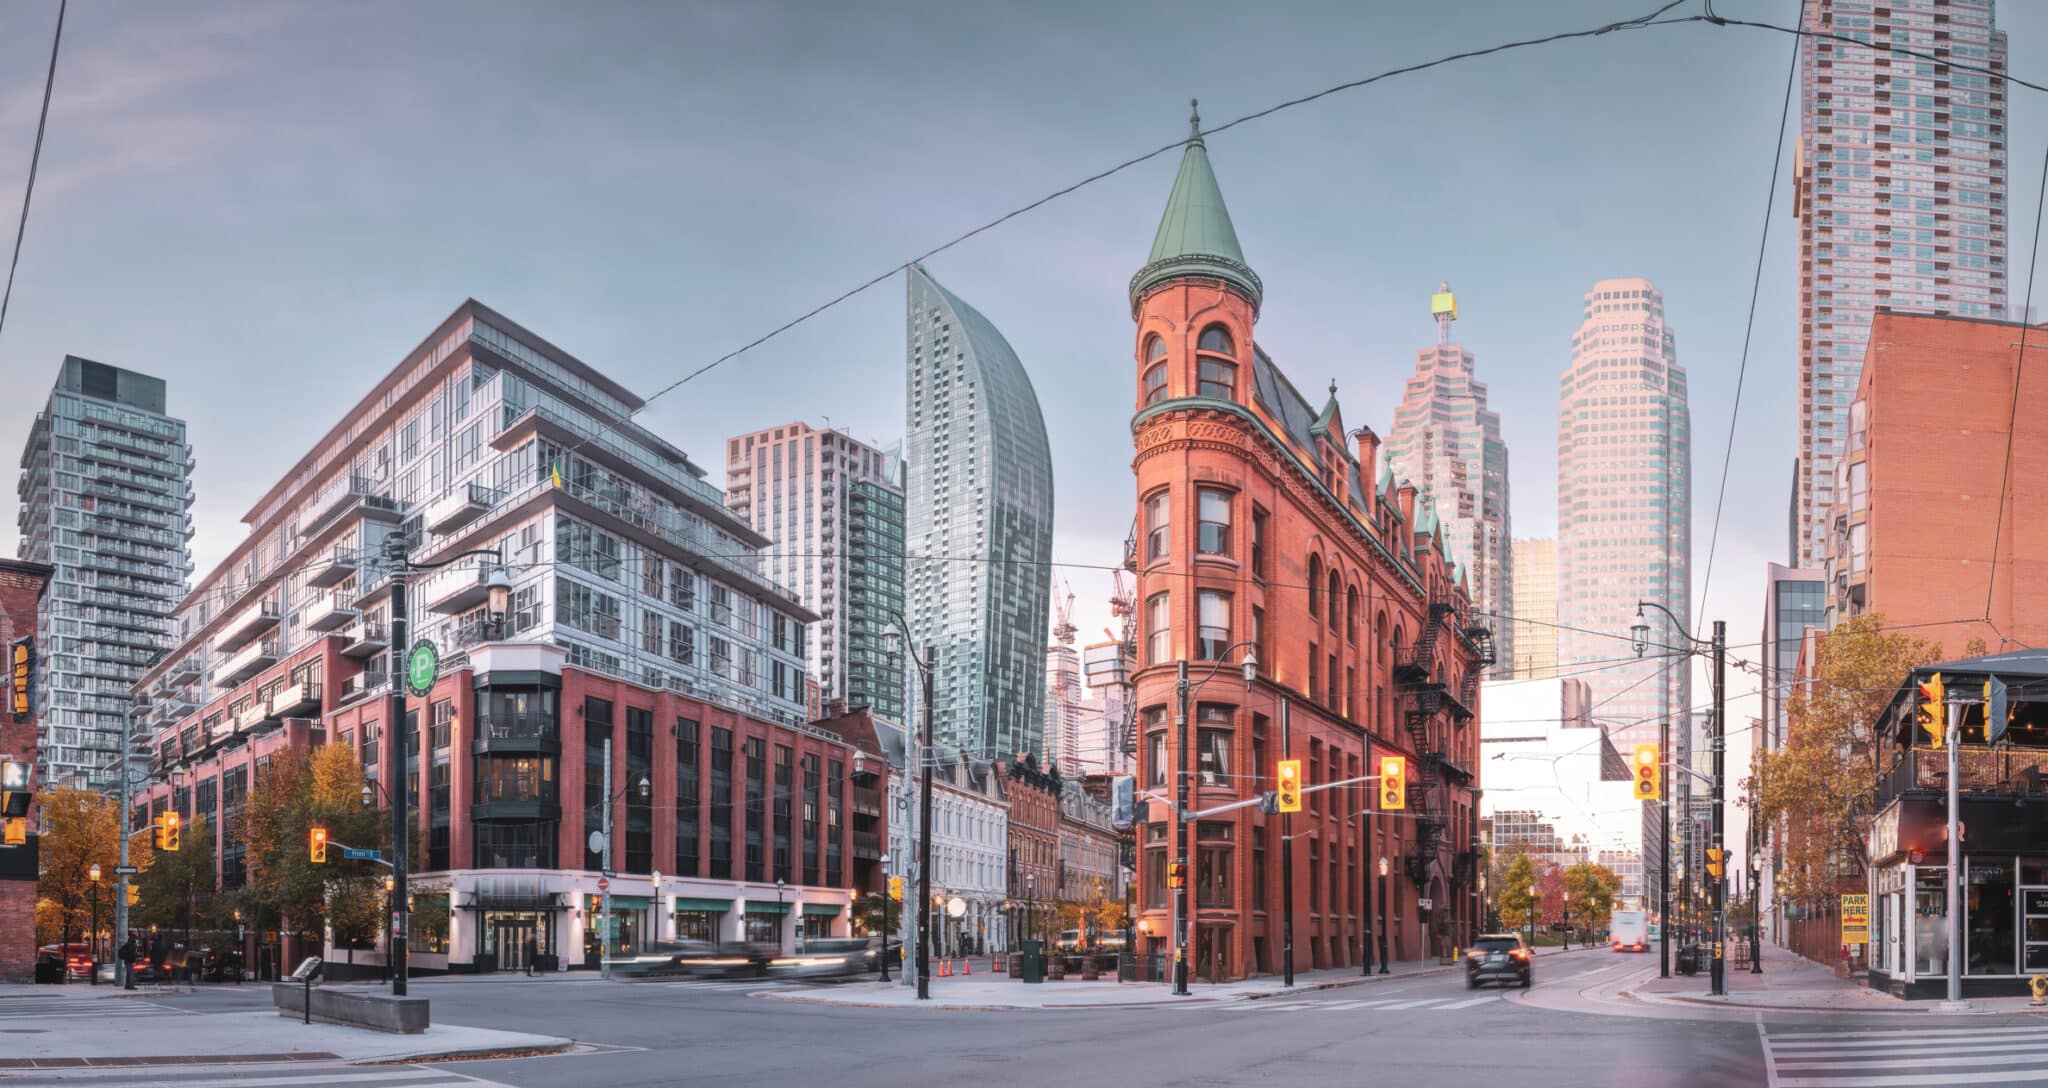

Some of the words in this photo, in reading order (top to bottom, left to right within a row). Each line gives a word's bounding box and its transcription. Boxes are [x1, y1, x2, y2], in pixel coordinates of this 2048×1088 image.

[416, 653, 430, 678] P
[1843, 895, 1866, 904] PARK
[1843, 906, 1867, 915] HERE
